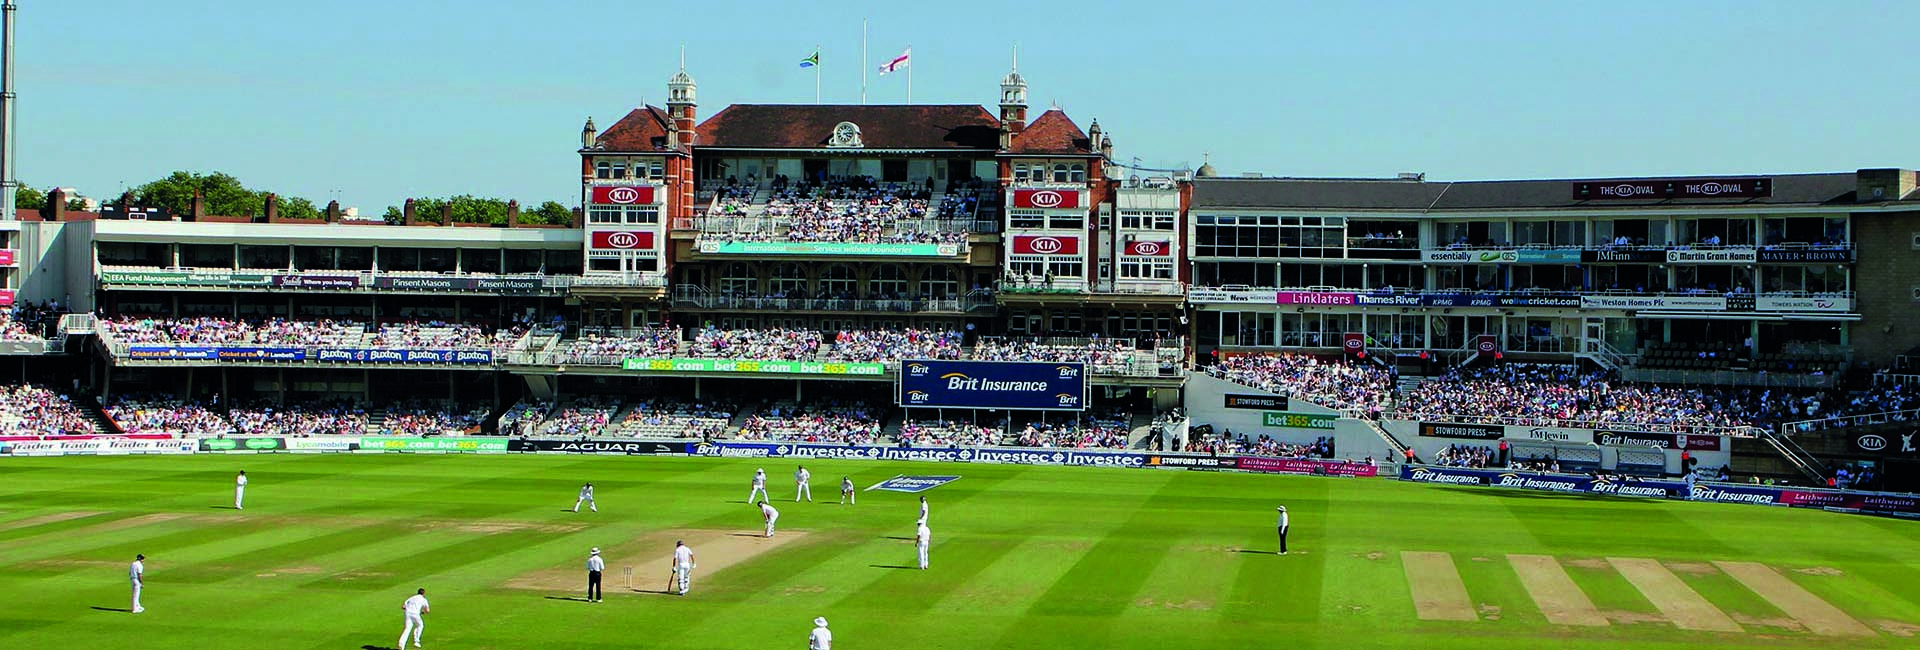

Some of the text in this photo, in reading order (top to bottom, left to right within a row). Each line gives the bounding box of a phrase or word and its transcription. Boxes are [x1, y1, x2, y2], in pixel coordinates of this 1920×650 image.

[1600, 186, 1614, 195] THE
[1635, 185, 1654, 194] OVAL
[1685, 185, 1700, 193] THE
[1722, 184, 1742, 193] OVAL
[842, 245, 869, 253] without
[871, 245, 912, 253] boundaries
[1430, 252, 1471, 262] essentially
[1680, 252, 1755, 261] Martin Grant Homes
[145, 275, 187, 284] Management
[334, 279, 353, 287] belong
[422, 279, 450, 287] Masons
[1292, 293, 1351, 304] Linklaters
[1357, 295, 1420, 304] Thames River
[1500, 297, 1579, 306] welivecricket.com
[1601, 298, 1627, 306] Weston
[1628, 299, 1653, 307] Homes
[320, 350, 352, 360] Buxton
[370, 351, 402, 361] Buxton
[408, 351, 440, 361] Buxton
[457, 351, 489, 362] Buxton
[627, 360, 704, 370] bet365.com
[713, 361, 791, 372] bet365.com
[800, 362, 878, 374] bet365.com
[911, 365, 929, 374] Brit
[1059, 367, 1077, 377] Brit
[947, 376, 1047, 392] Brit Insurance
[911, 392, 928, 401] Brit
[1059, 395, 1077, 404] Brit
[1236, 398, 1275, 407] STOWFORD PRESS
[1435, 426, 1486, 437] STOWFORD PRESS
[12, 442, 54, 450] Trader
[60, 442, 100, 450] Trader
[110, 440, 150, 449] Trader
[155, 441, 195, 449] Trader
[296, 441, 348, 449] Lycamobile
[364, 440, 434, 448] bet365.com
[438, 441, 505, 450] bet365.com
[1601, 435, 1669, 448] Brit Insurance
[553, 443, 640, 451] JAGUAR
[697, 445, 769, 455] Brit Insurance
[791, 444, 865, 457] Investec
[882, 447, 957, 460] Investec
[974, 449, 1049, 462] Investec
[1067, 451, 1144, 465] Investec
[1161, 457, 1196, 466] STOWFORD
[1197, 458, 1218, 467] PRESS
[1412, 470, 1480, 484] Brit Insuranc
[1500, 476, 1575, 490] Brit Insurance
[1592, 482, 1666, 496] Brit Insuranc
[1692, 488, 1773, 503] Brit Insurance
[1794, 494, 1844, 502] Laithwaite's
[1864, 496, 1915, 506] Laithwaite's
